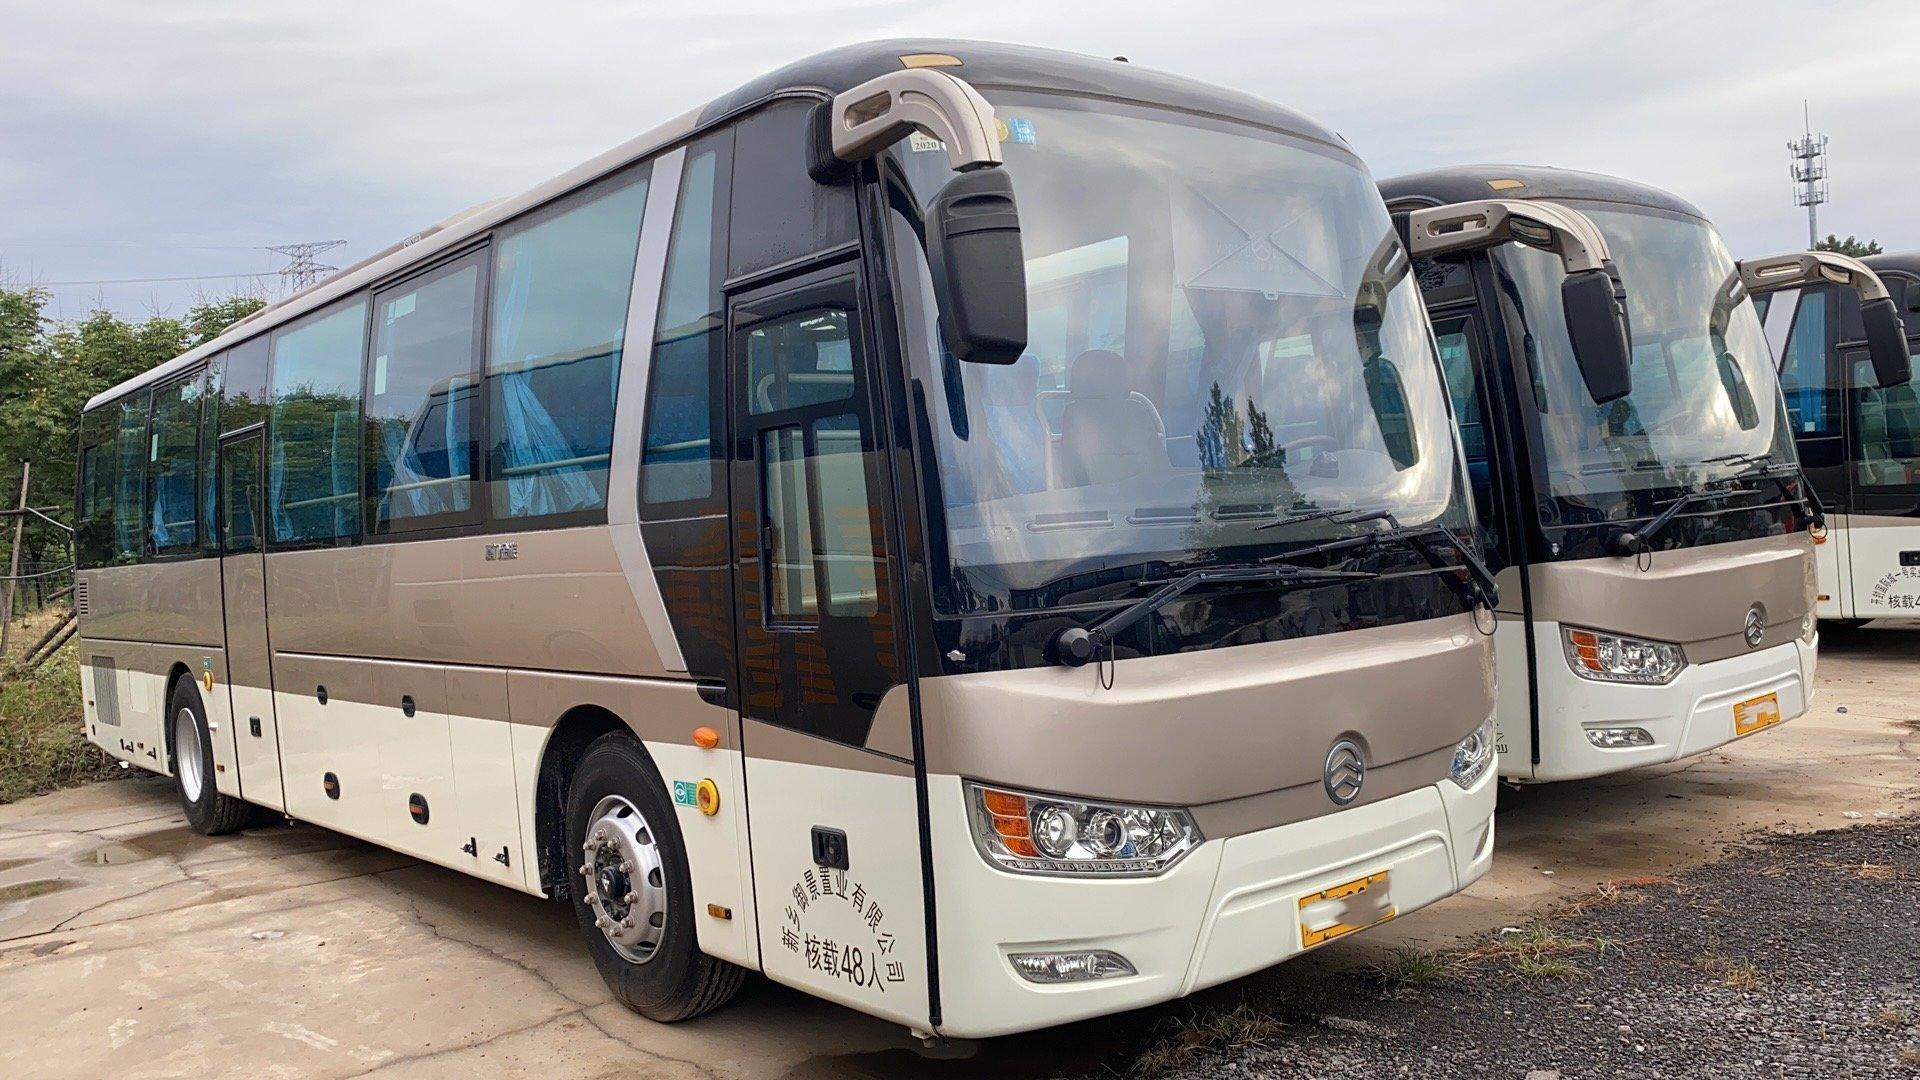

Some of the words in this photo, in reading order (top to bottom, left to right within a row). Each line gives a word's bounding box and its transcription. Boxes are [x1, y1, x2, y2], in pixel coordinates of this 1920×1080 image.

[915, 142, 937, 150] 2020
[804, 932, 885, 993] 核载48人
